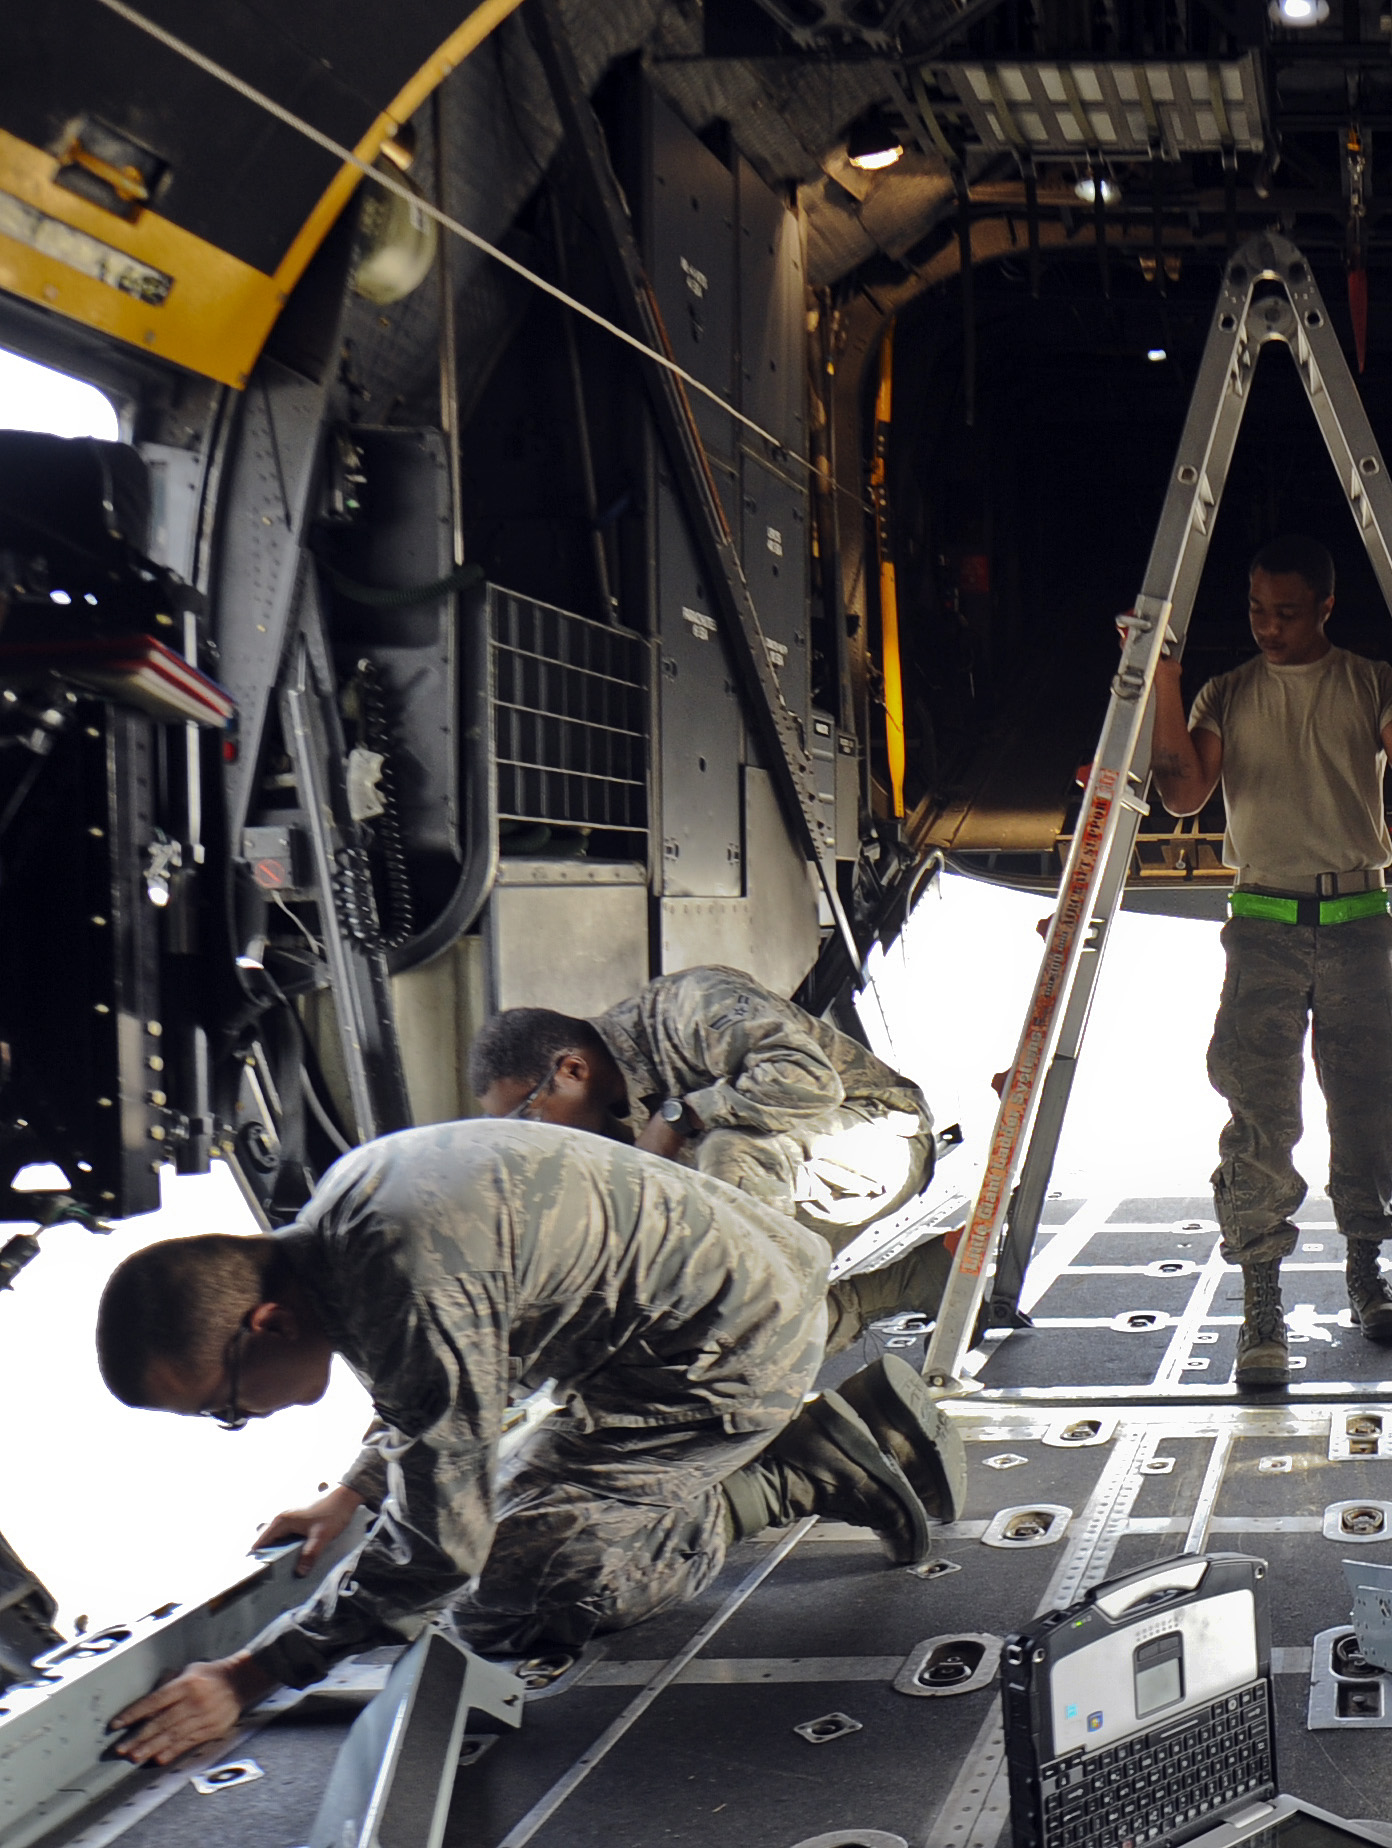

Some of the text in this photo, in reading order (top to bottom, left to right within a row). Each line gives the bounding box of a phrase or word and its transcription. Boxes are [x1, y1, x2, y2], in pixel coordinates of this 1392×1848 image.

[963, 1223, 990, 1272] Little
[979, 1175, 1002, 1221] Giant
[992, 1110, 1021, 1170] Ladder
[1012, 1030, 1043, 1106] Systems
